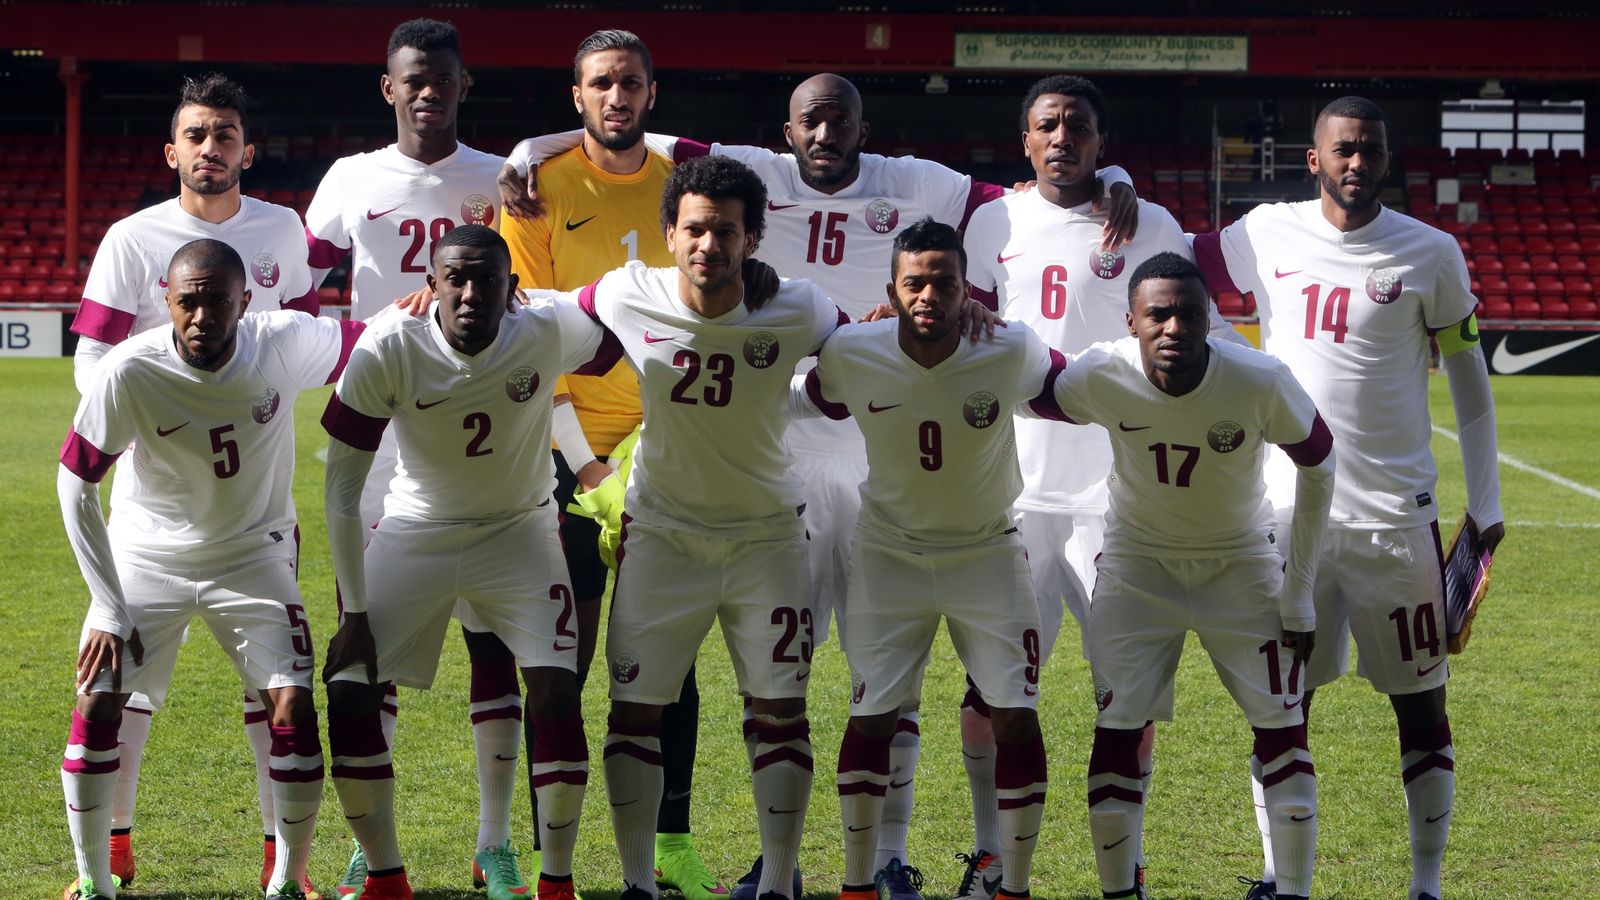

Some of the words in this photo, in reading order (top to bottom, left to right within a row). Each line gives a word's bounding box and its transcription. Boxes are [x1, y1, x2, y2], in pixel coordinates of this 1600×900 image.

[995, 35, 1077, 48] SUPPORTED
[1080, 36, 1162, 49] COMMUNITY
[1166, 37, 1235, 50] BUSINESS
[1010, 48, 1064, 62] Putting
[1068, 49, 1094, 60] Our
[1099, 50, 1147, 62] Future
[1152, 51, 1211, 63] Together
[620, 229, 638, 261] 1
[806, 211, 849, 266] 15
[1041, 265, 1068, 320] 6
[1100, 269, 1113, 277] QFA
[1375, 294, 1389, 302] QFA
[0, 322, 31, 349] B
[1302, 284, 1351, 344] 14
[670, 350, 735, 407] 23
[754, 359, 768, 367] QFA
[209, 423, 241, 480] 5
[463, 412, 493, 457] 2
[919, 420, 943, 472] 9
[1148, 443, 1200, 488] 17
[285, 604, 313, 657] 5
[549, 583, 577, 640] 2
[771, 606, 814, 665] 23
[1388, 602, 1441, 662] 14
[1022, 629, 1041, 684] 9
